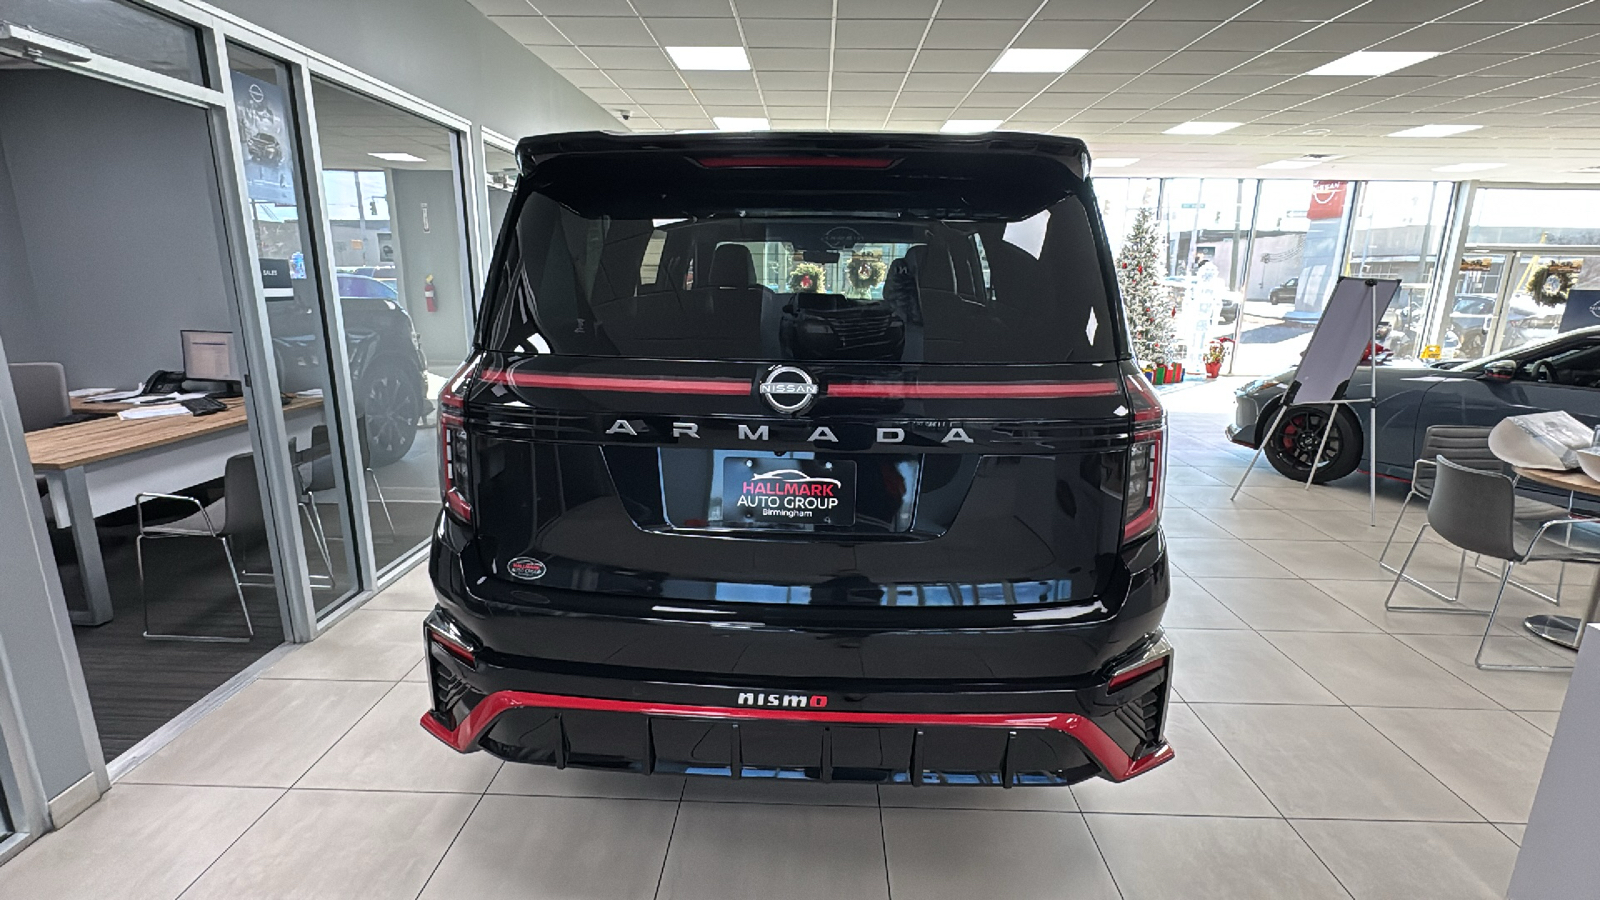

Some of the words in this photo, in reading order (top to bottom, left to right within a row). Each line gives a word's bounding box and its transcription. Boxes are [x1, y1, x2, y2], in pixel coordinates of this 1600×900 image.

[761, 384, 816, 393] NISSAN
[605, 419, 974, 443] ARMADA
[742, 481, 834, 497] HALLMARK
[737, 495, 780, 508] AUTO
[784, 496, 838, 509] GROUP
[762, 508, 813, 518] Birmingham
[738, 692, 828, 707] nismo
